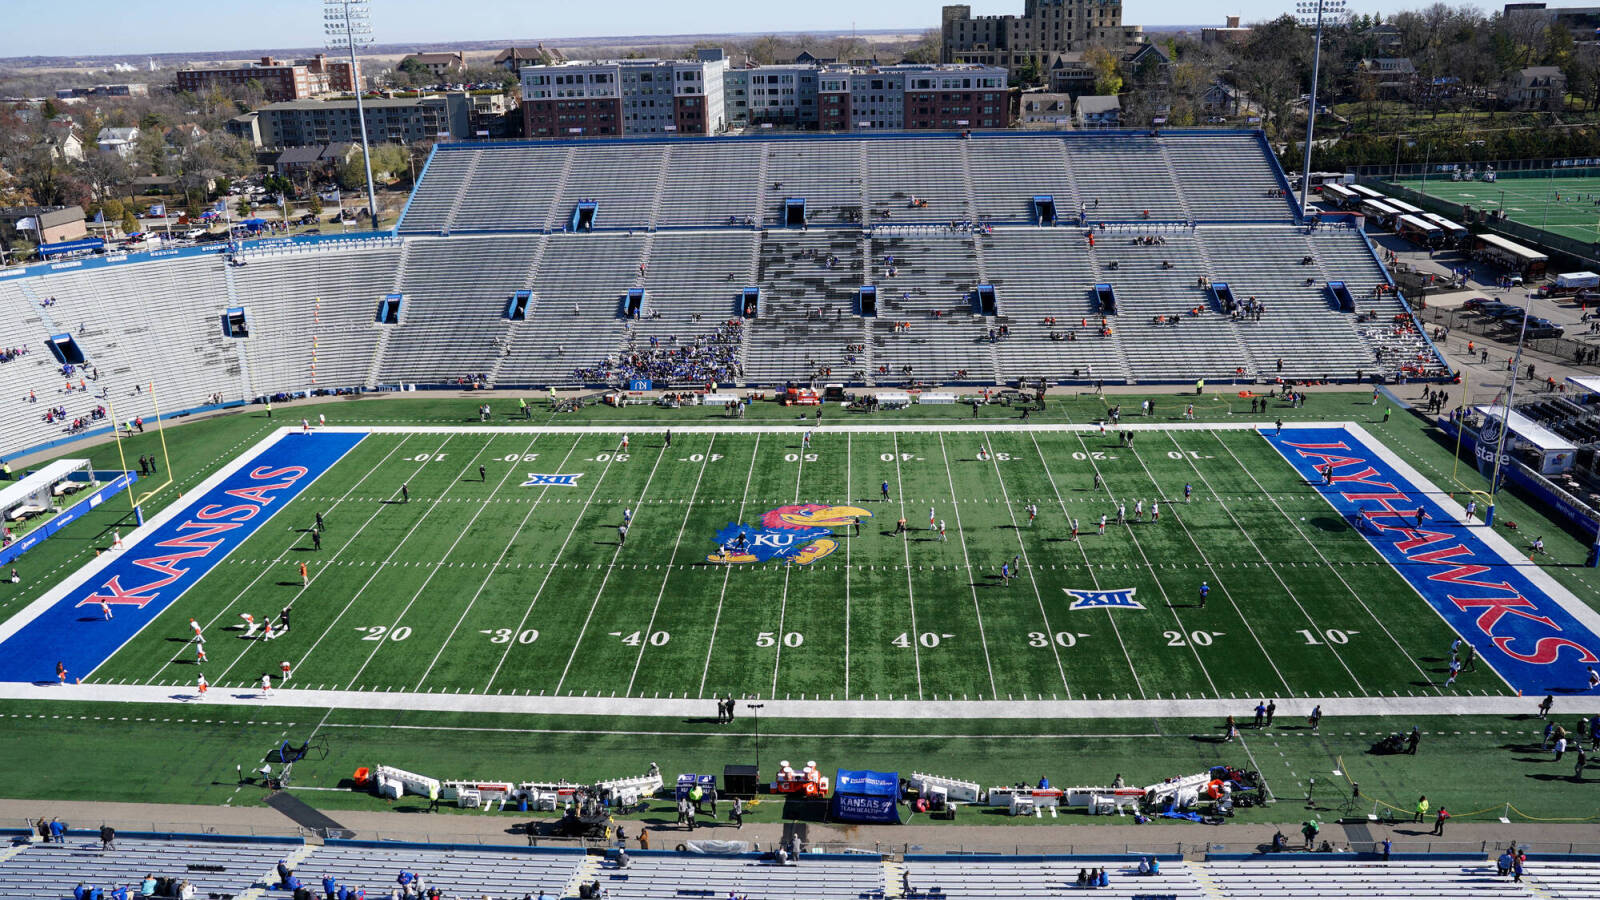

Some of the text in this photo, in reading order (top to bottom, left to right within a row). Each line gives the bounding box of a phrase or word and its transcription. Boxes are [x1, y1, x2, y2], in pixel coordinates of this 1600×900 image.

[413, 454, 449, 462] 10
[504, 454, 541, 462] 20
[595, 454, 631, 462] 30
[689, 453, 725, 462] 40
[784, 453, 819, 462] 50
[880, 453, 914, 462] 40
[1072, 451, 1107, 460] 20
[1167, 450, 1204, 460] 10
[526, 474, 579, 485] XII
[75, 465, 308, 609] KANSAS
[753, 534, 795, 547] KU
[1281, 440, 1599, 664] JAYHAWKS
[1069, 588, 1138, 608] XII
[361, 626, 412, 641] 20
[490, 629, 539, 644] 30
[621, 631, 670, 646] 40
[756, 632, 804, 647] 50
[891, 632, 940, 648] 40
[1028, 631, 1077, 648] 30
[1163, 630, 1213, 647] 20
[1296, 629, 1349, 645] 10
[840, 797, 879, 808] KANSAS
